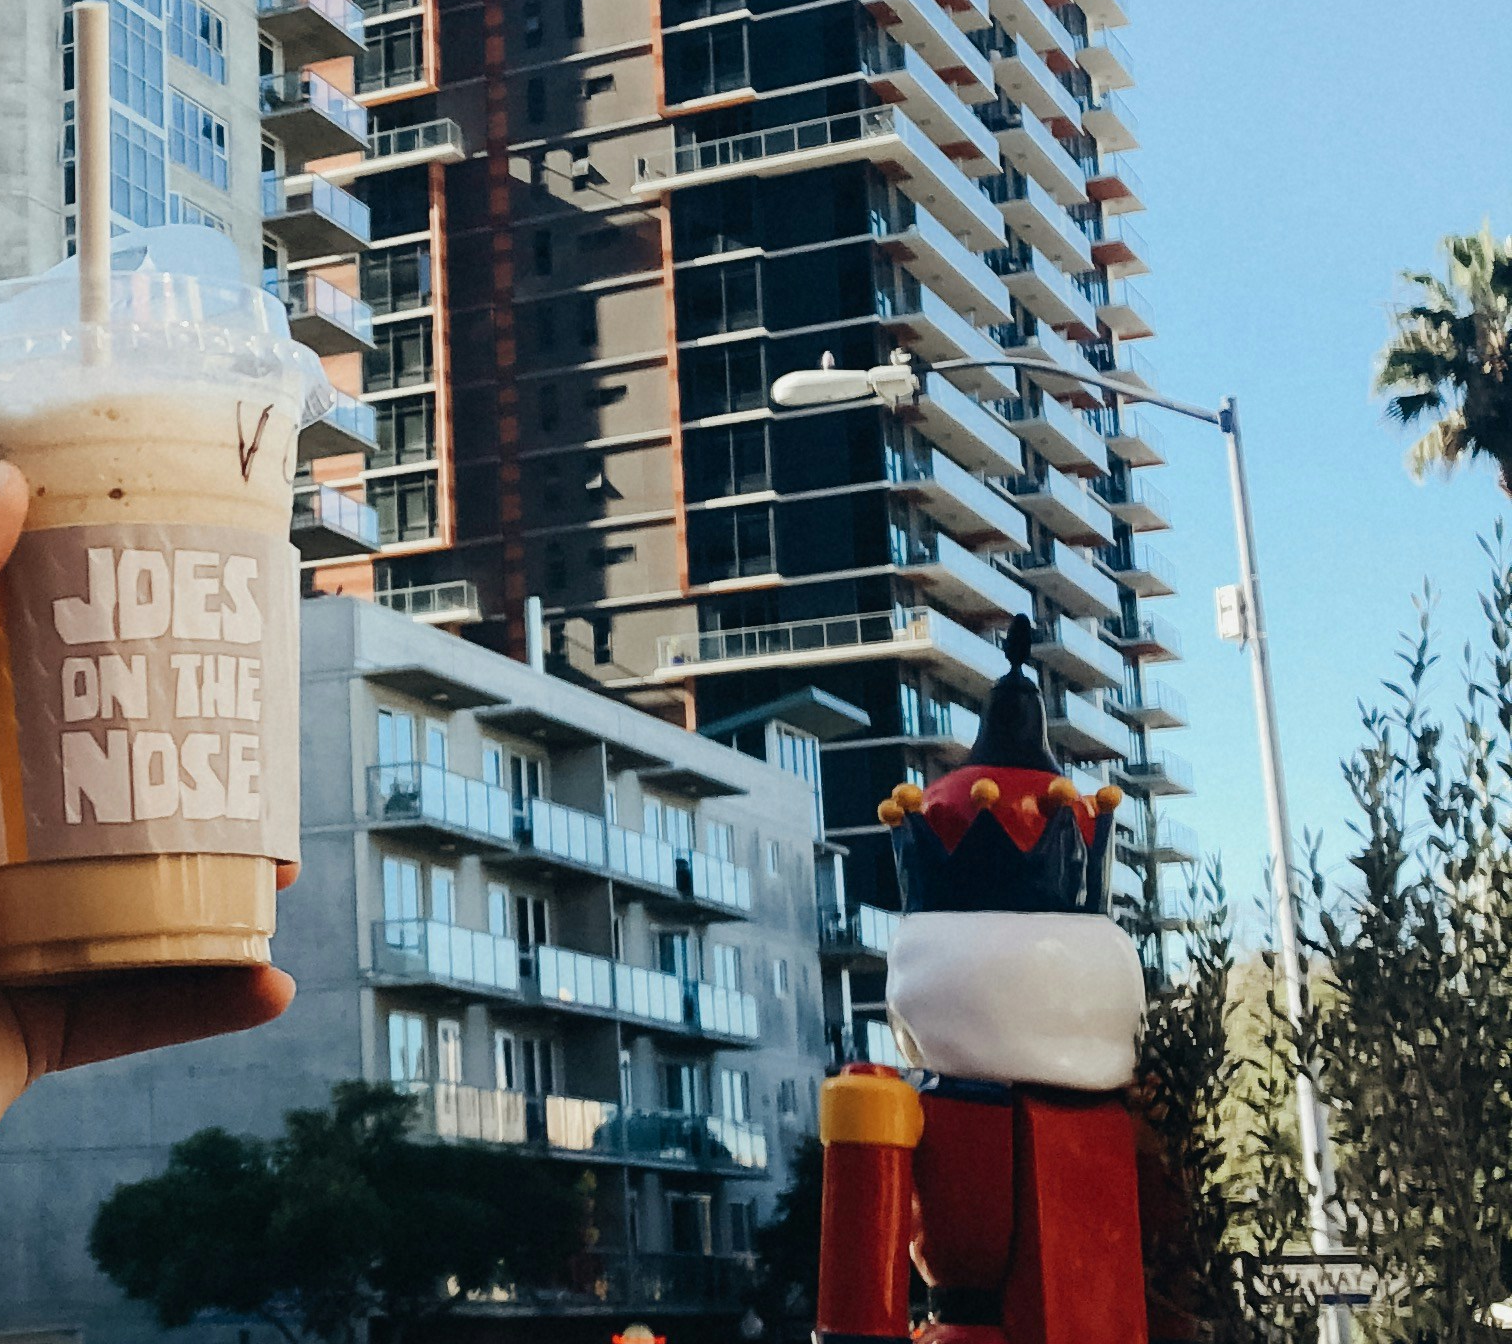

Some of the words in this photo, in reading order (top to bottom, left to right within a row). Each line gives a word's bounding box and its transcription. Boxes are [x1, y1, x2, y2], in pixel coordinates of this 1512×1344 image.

[53, 548, 262, 645] JOES
[61, 655, 150, 723] ON
[170, 654, 262, 722] THE
[61, 730, 262, 825] NOSE
